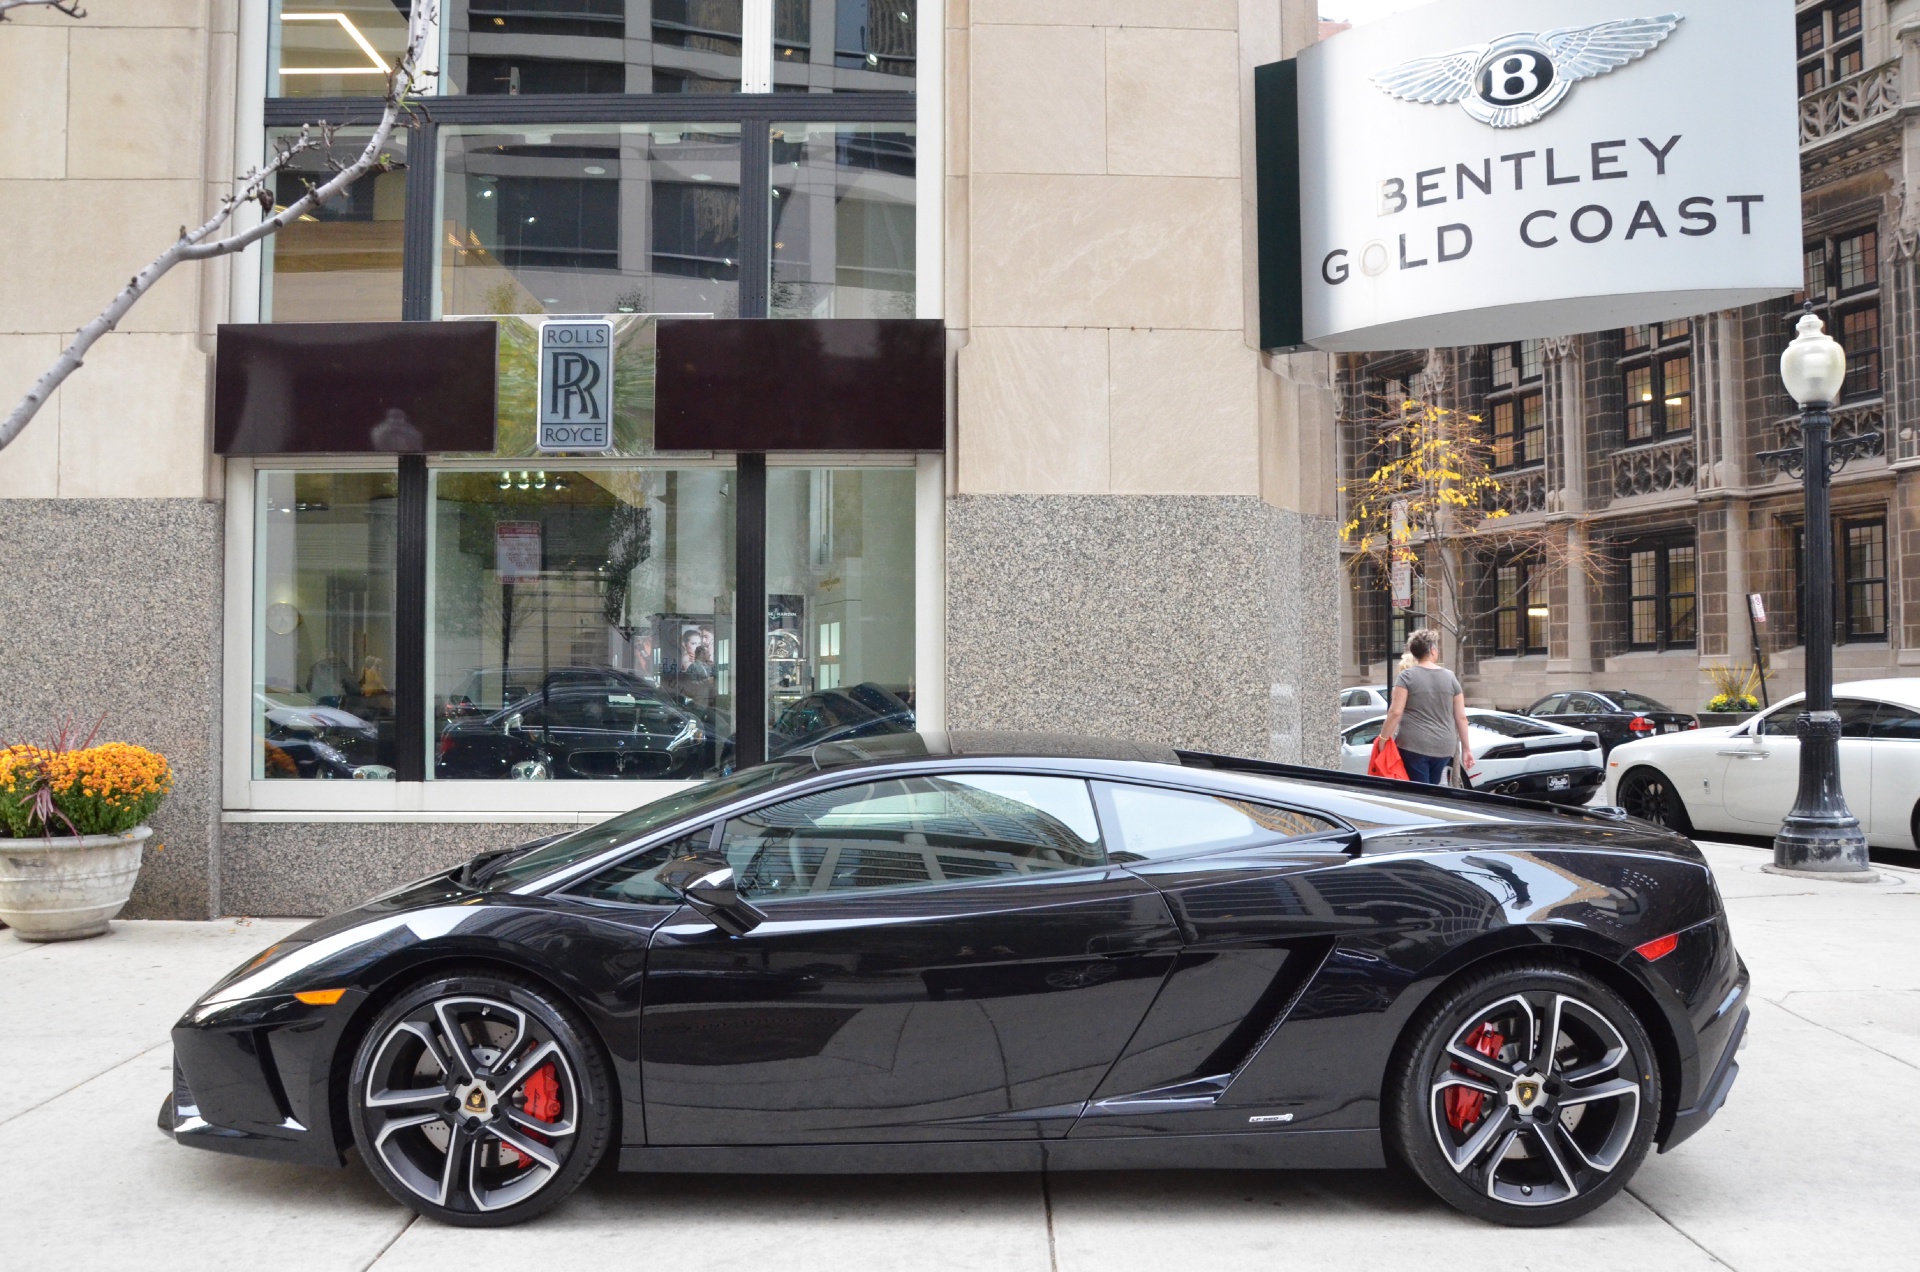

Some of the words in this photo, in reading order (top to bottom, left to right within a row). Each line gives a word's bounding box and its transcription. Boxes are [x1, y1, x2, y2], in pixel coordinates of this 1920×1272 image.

[1489, 53, 1538, 101] B
[1376, 134, 1683, 218] BENTLEY
[1321, 222, 1473, 285] GOLD
[1519, 194, 1764, 248] COAST
[547, 329, 604, 343] ROLLS
[545, 427, 603, 442] ROYCE
